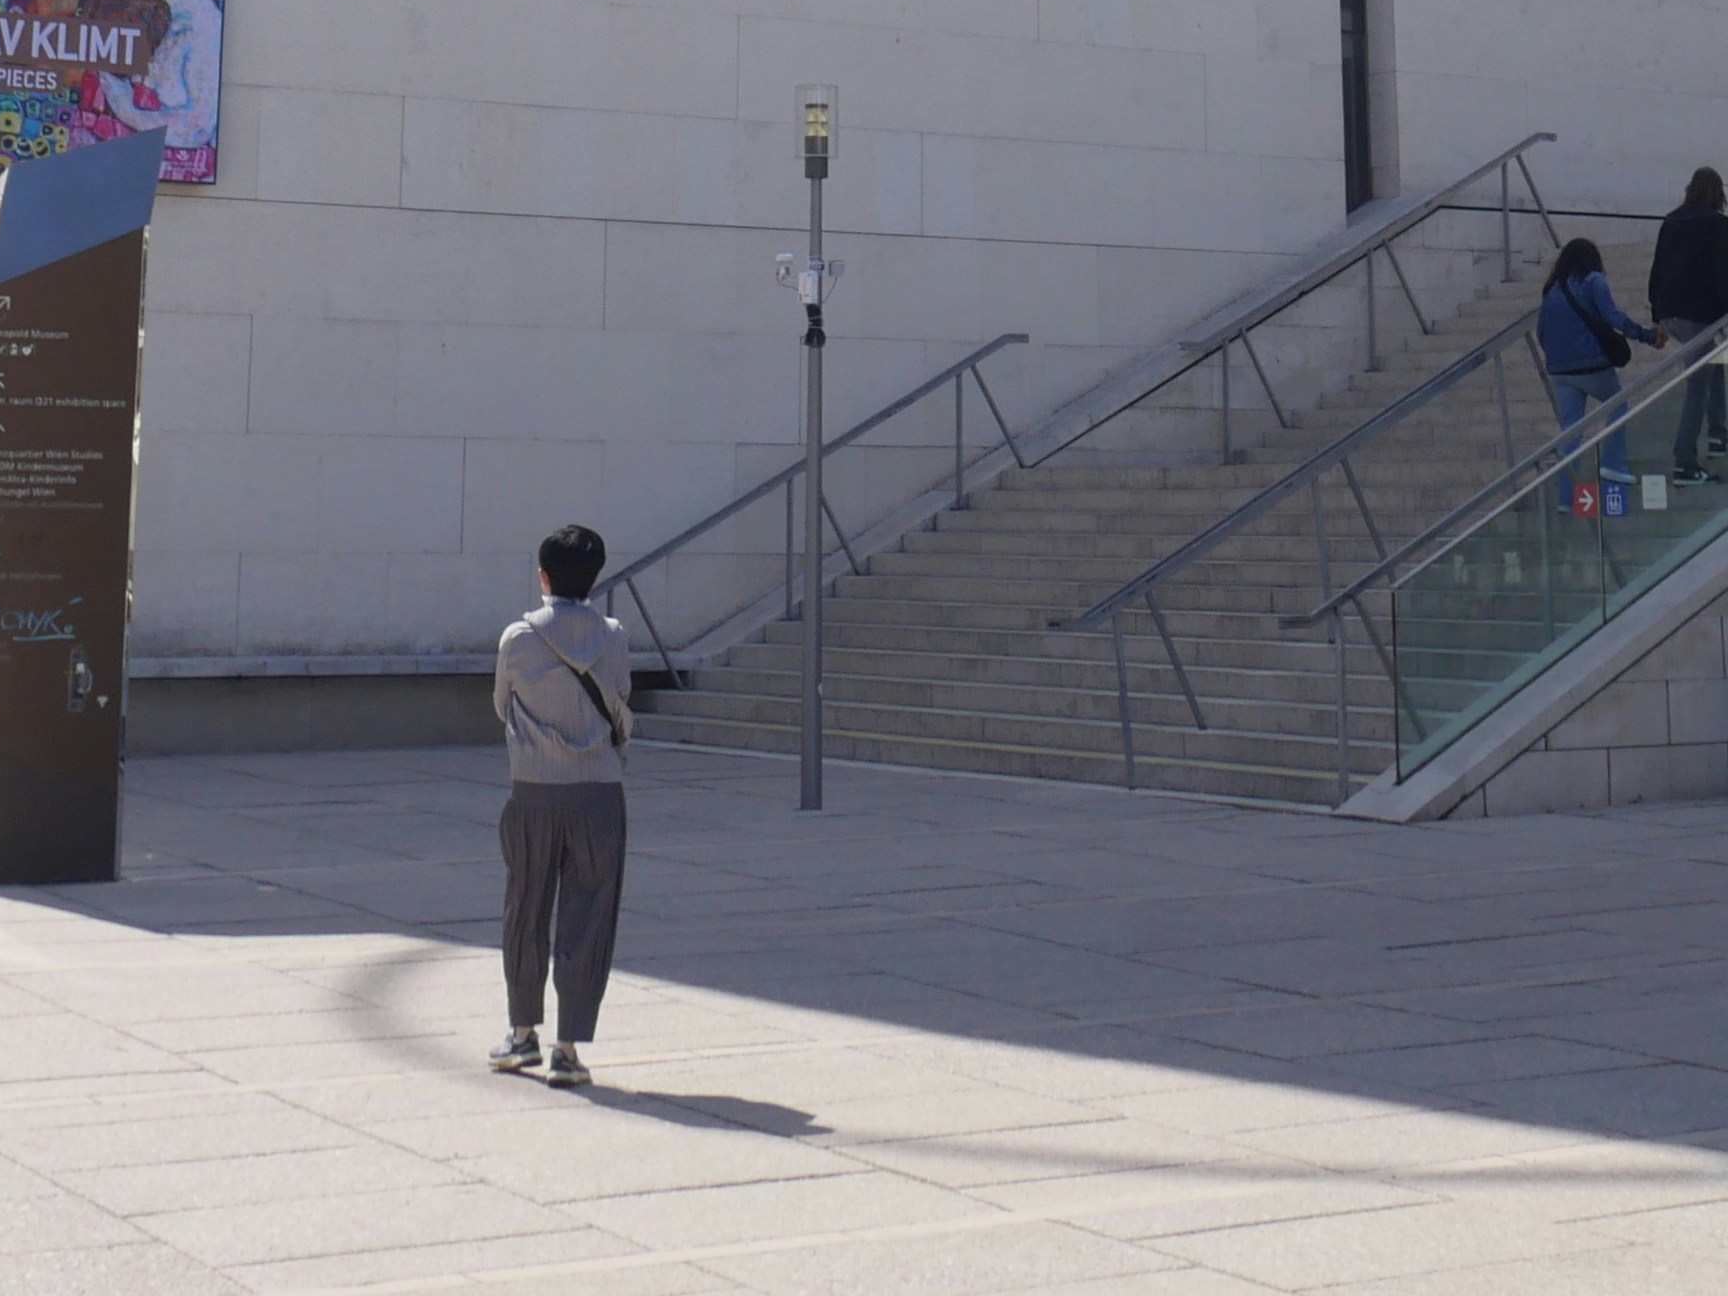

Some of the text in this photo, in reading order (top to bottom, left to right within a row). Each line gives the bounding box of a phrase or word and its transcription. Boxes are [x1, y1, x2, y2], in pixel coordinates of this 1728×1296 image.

[31, 20, 141, 66] KLIMT
[30, 329, 69, 340] Museum
[35, 396, 54, 406] Q21
[55, 397, 101, 407] exhibition
[45, 449, 69, 459] Wien
[32, 487, 56, 497] Wien
